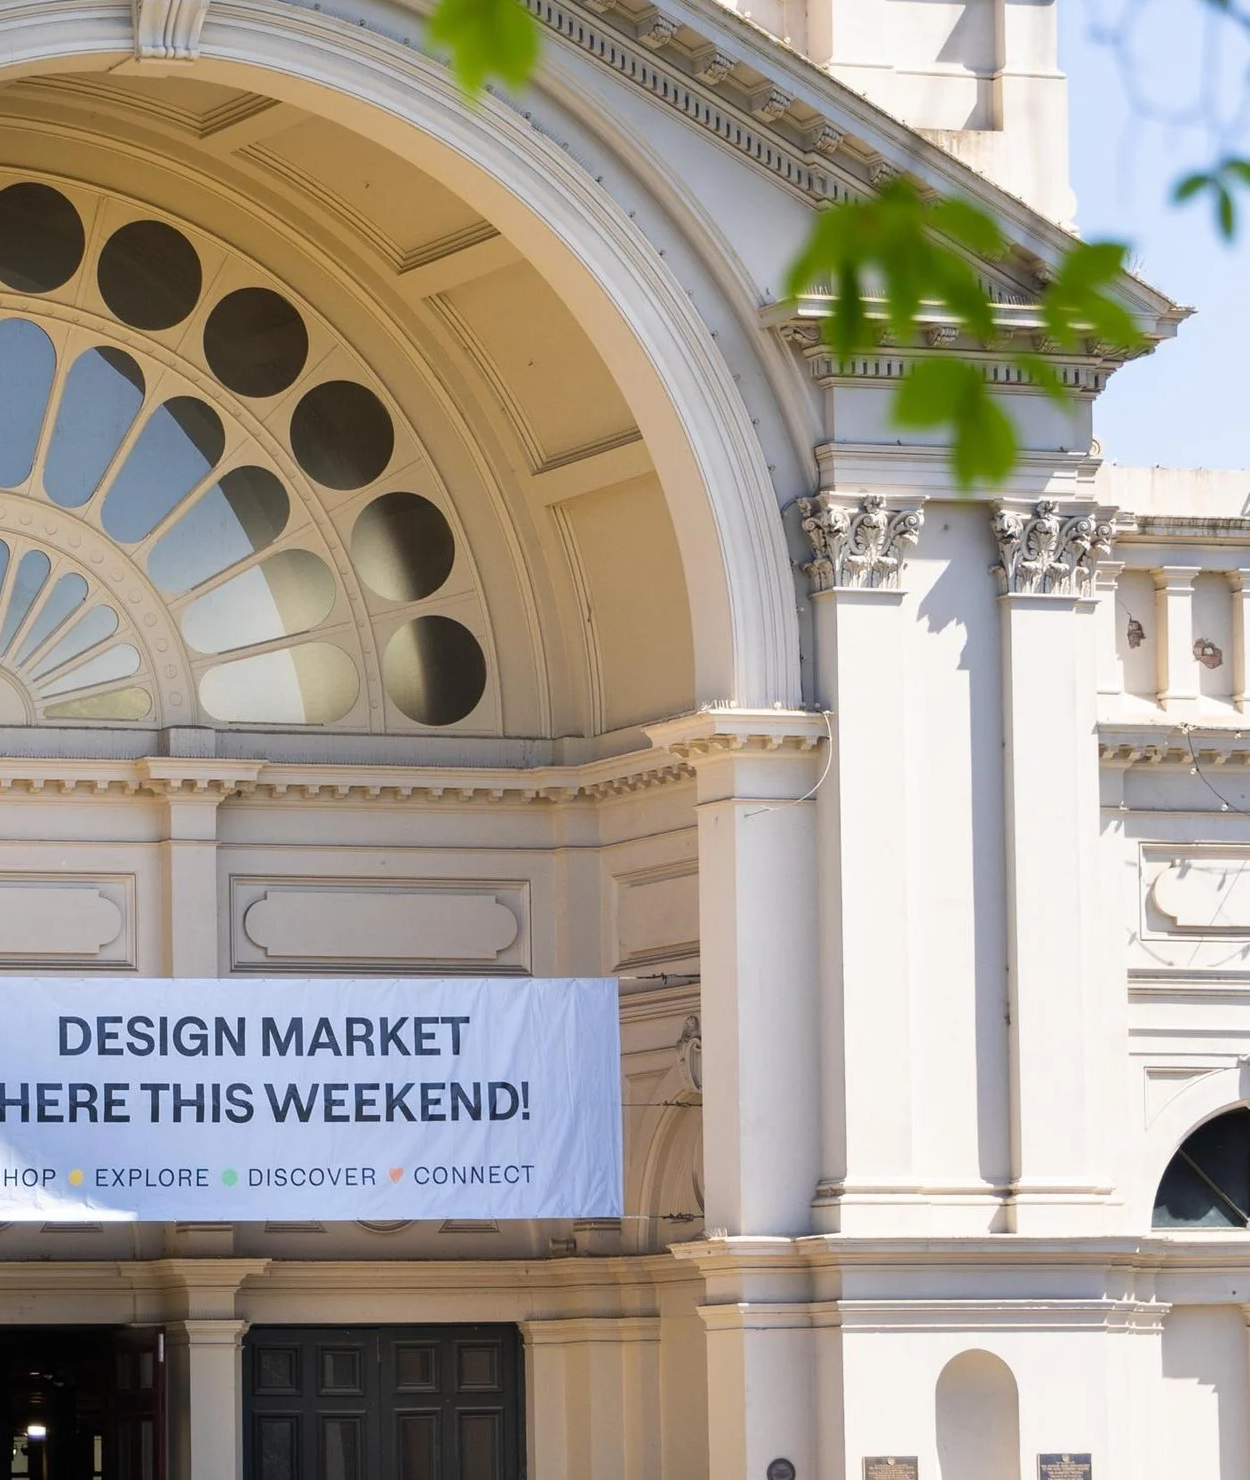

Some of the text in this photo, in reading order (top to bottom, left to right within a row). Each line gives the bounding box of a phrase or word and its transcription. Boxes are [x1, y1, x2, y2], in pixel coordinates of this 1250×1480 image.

[58, 1015, 471, 1057] DESIGN MARKET
[139, 1082, 255, 1124] THIS
[263, 1080, 531, 1124] WEEKEND!
[95, 1168, 210, 1188] EXPLORE
[248, 1167, 376, 1188] DISCOVER
[413, 1164, 535, 1187] CONNECT
